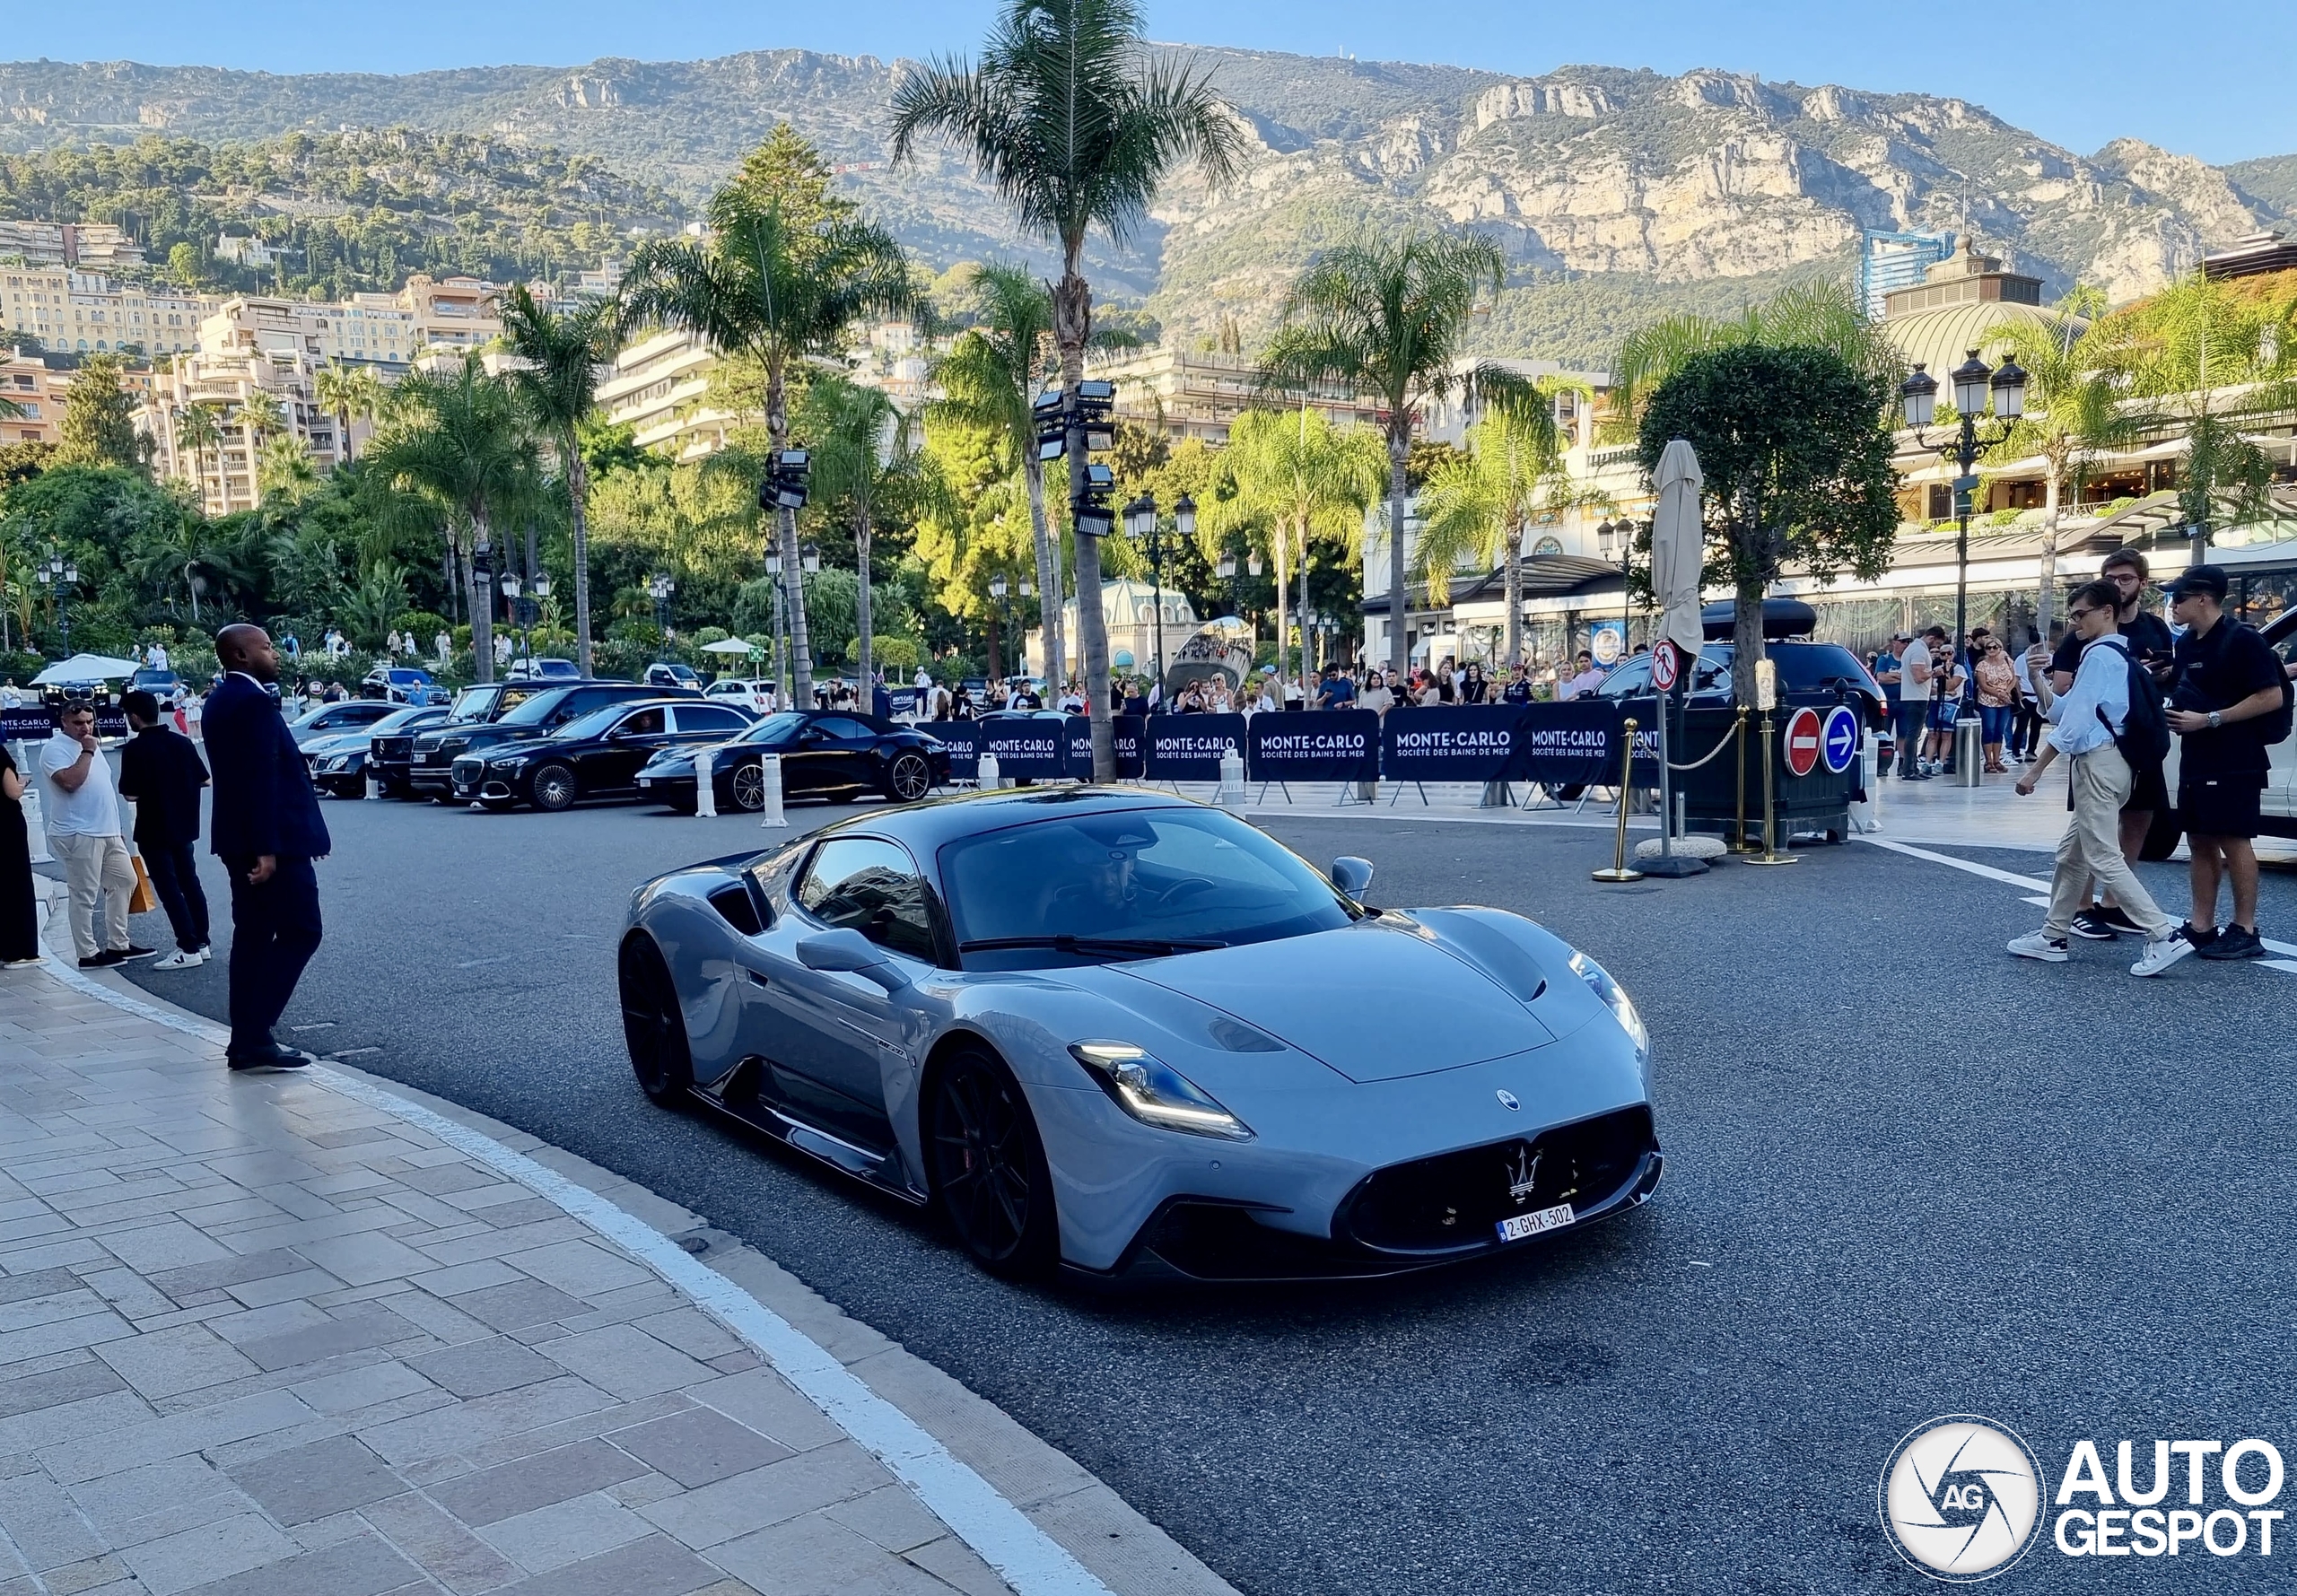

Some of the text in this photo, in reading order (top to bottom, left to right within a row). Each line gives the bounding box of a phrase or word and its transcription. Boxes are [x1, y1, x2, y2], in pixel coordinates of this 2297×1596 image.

[1, 719, 50, 727] NTE·CARLO
[1180, 751, 1192, 759] DES
[1193, 751, 1211, 759] BAINS
[1212, 751, 1221, 759] DE
[1261, 749, 1292, 759] SOCIÉTÉ
[1311, 750, 1334, 758] BAINS
[1349, 749, 1365, 757] MER
[1397, 747, 1510, 757] SOCIÉTÉ DES BAINS DE MER
[1555, 747, 1567, 756] DES
[1507, 1206, 1572, 1237] 2-GHX-502
